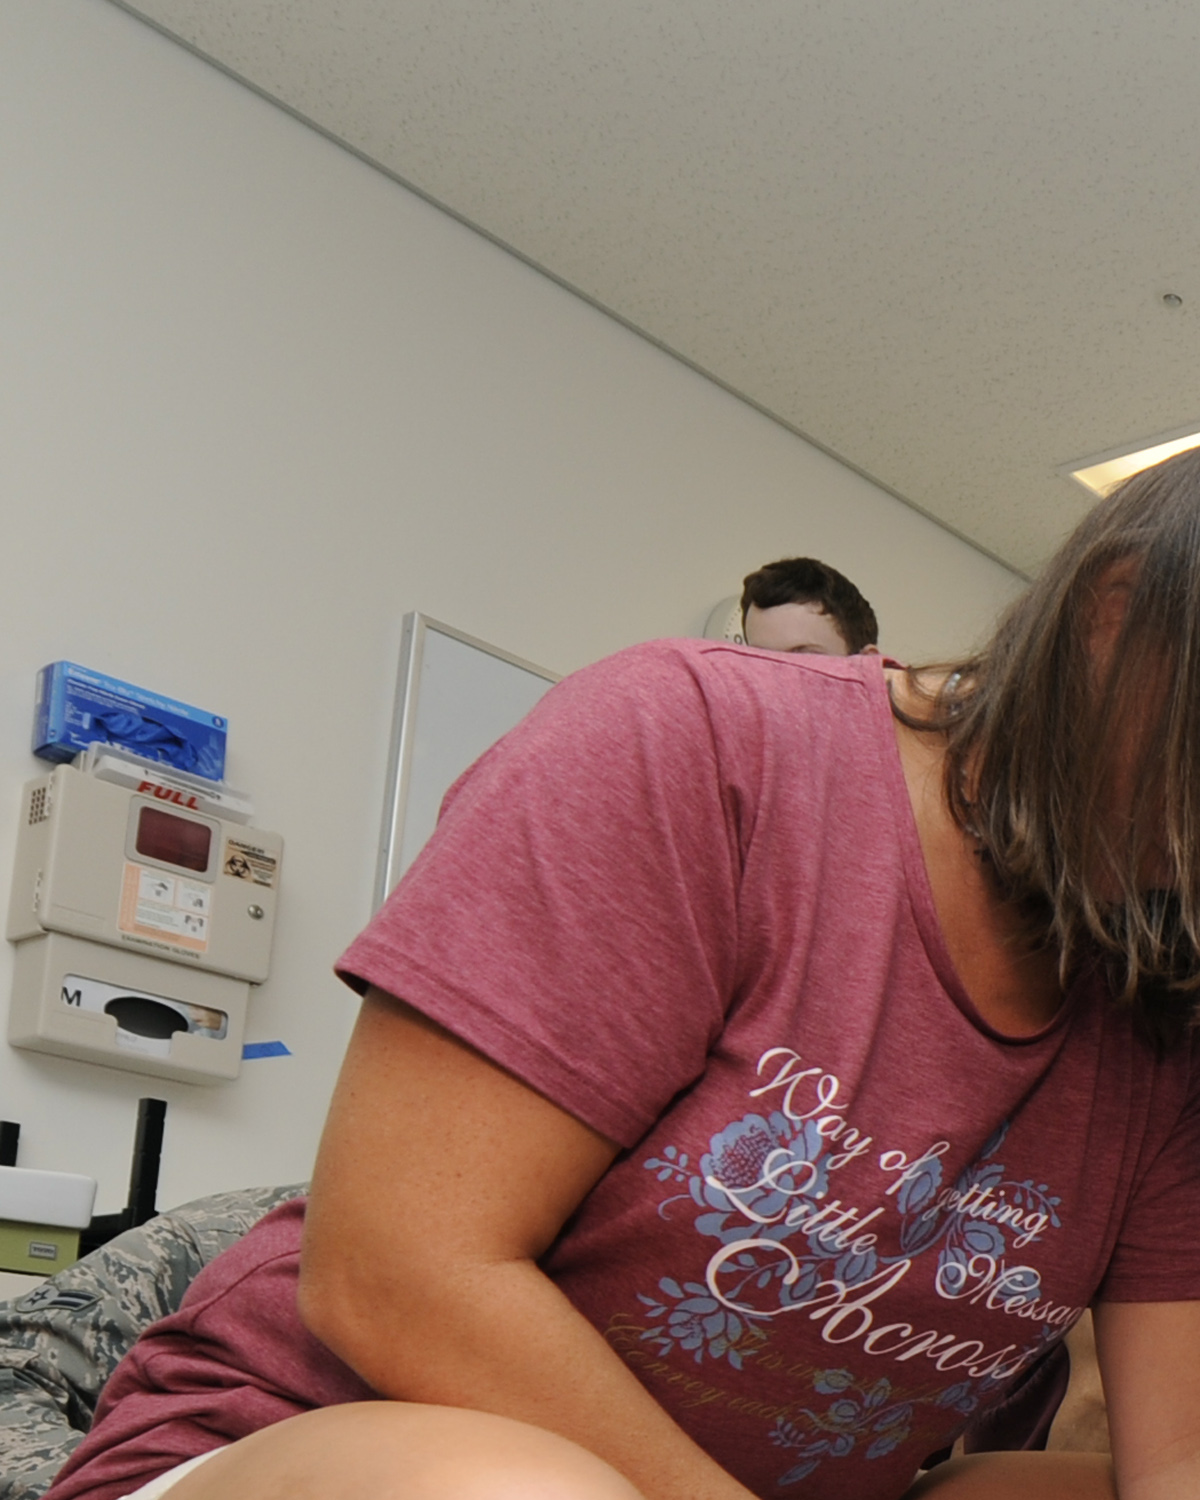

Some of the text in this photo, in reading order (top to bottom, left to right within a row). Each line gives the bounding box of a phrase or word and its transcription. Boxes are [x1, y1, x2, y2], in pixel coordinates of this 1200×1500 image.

[137, 780, 199, 811] FULL
[61, 986, 82, 1007] M
[706, 1148, 886, 1255] Little
[749, 1047, 1049, 1249] Way of getting
[706, 1238, 1040, 1379] Across
